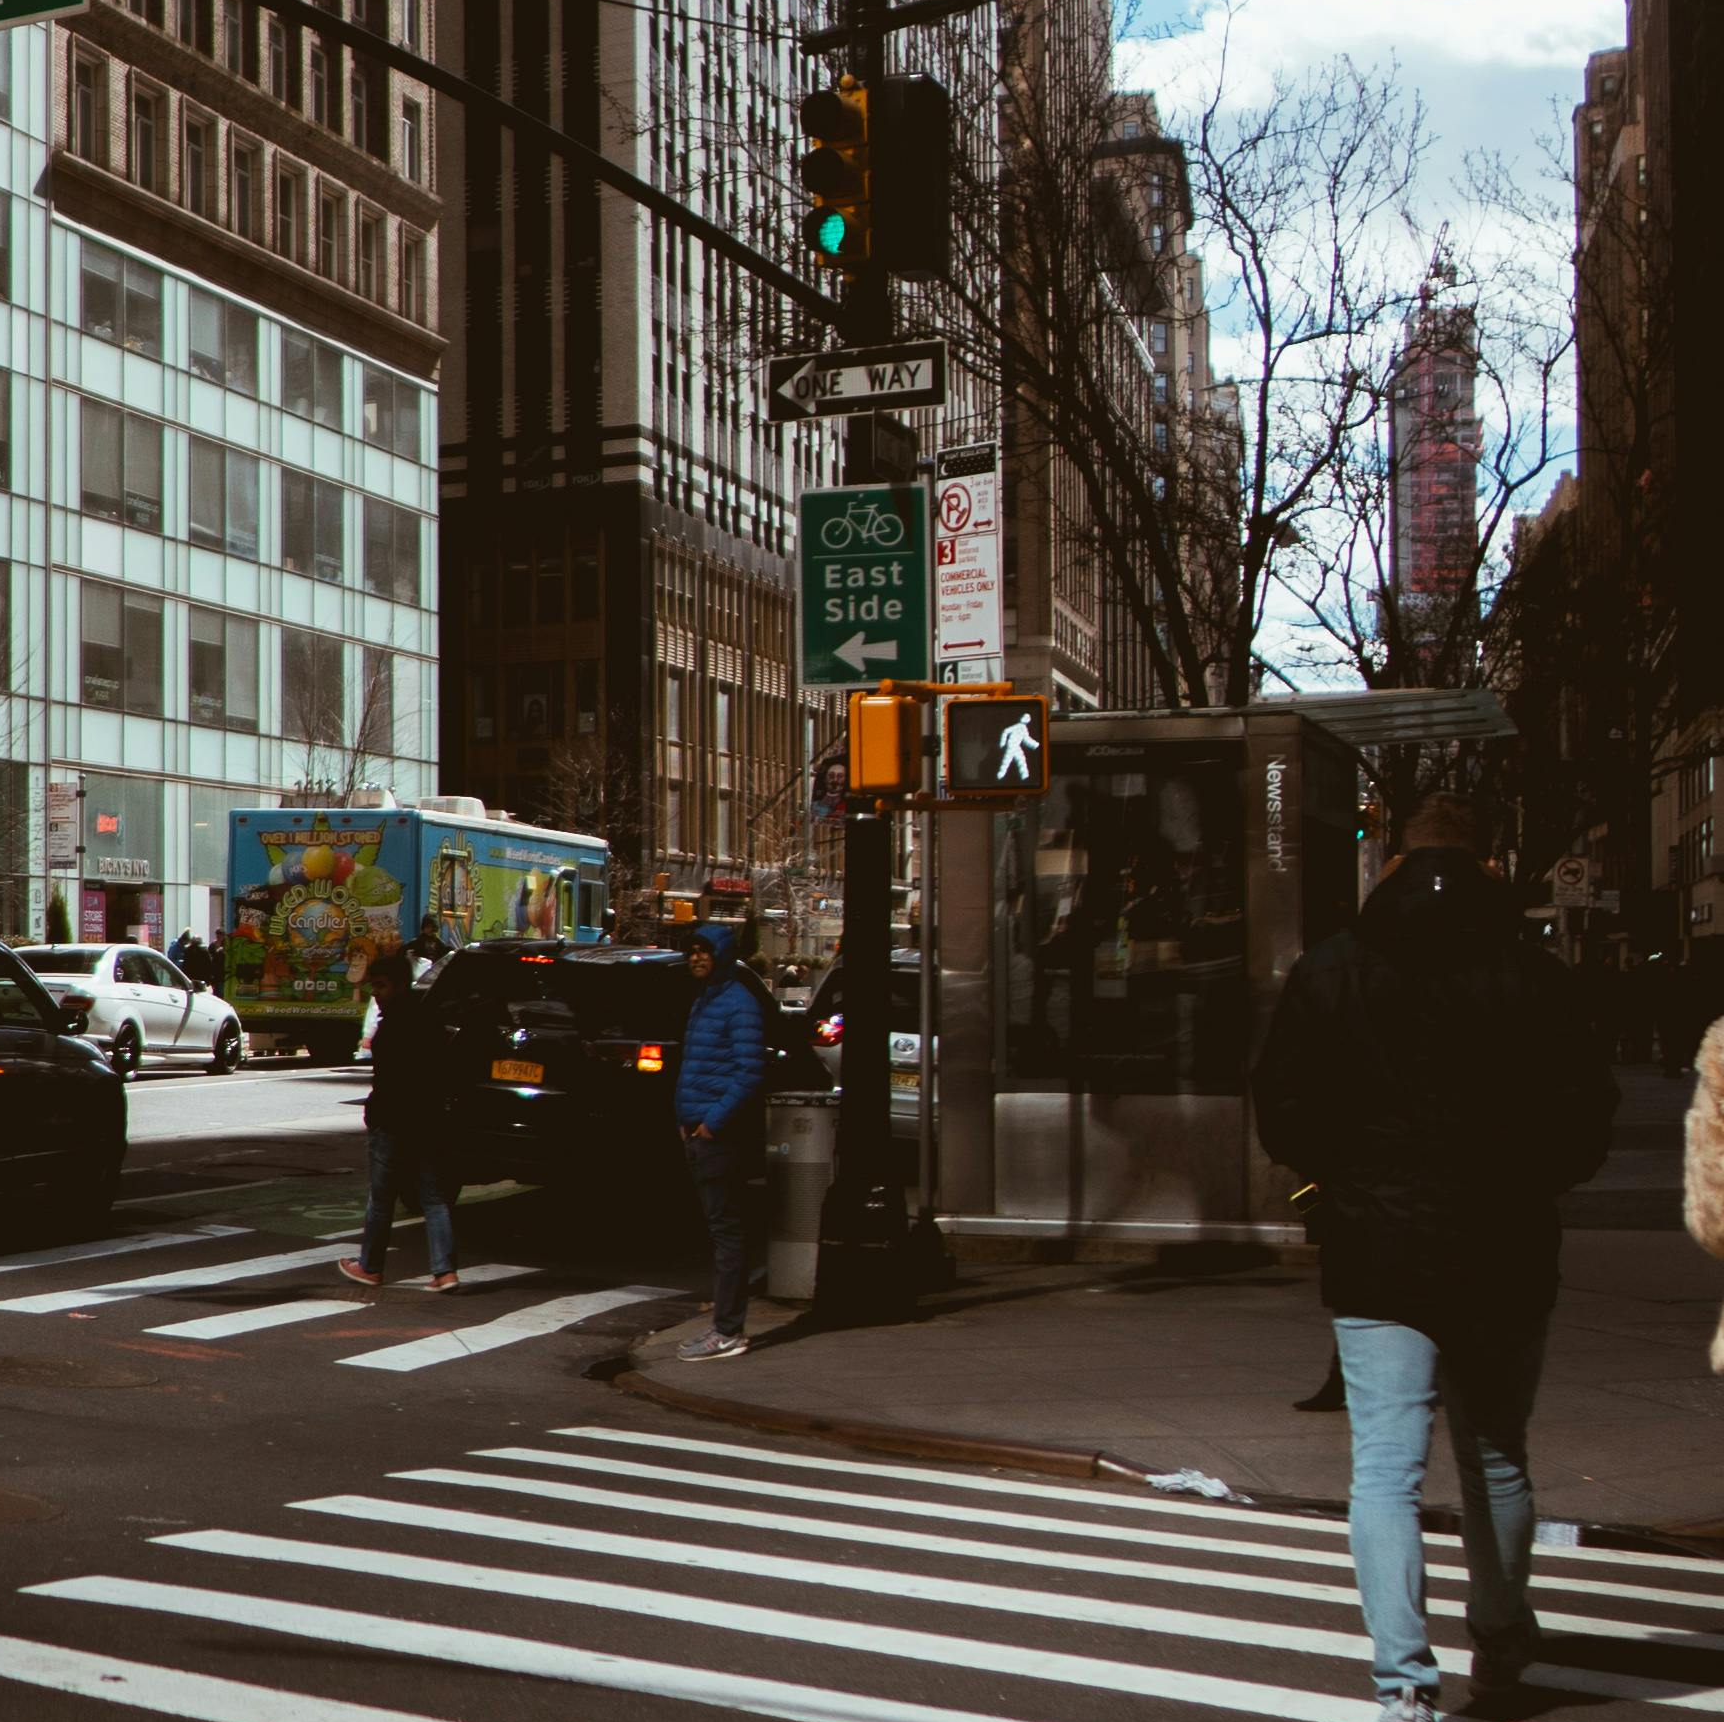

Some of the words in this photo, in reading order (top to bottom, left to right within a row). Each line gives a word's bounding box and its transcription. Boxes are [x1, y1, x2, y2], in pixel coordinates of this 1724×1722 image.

[795, 371, 843, 401] ONE
[866, 363, 922, 392] WAY
[942, 540, 952, 563] 3
[824, 561, 904, 589] East
[940, 567, 987, 583] COMMERCIAL
[940, 582, 975, 596] VEHICLES
[977, 580, 995, 592] ONLY
[825, 595, 904, 623] Side
[944, 663, 954, 684] 6
[1266, 754, 1287, 872] Newsstand
[288, 912, 349, 932] Candies
